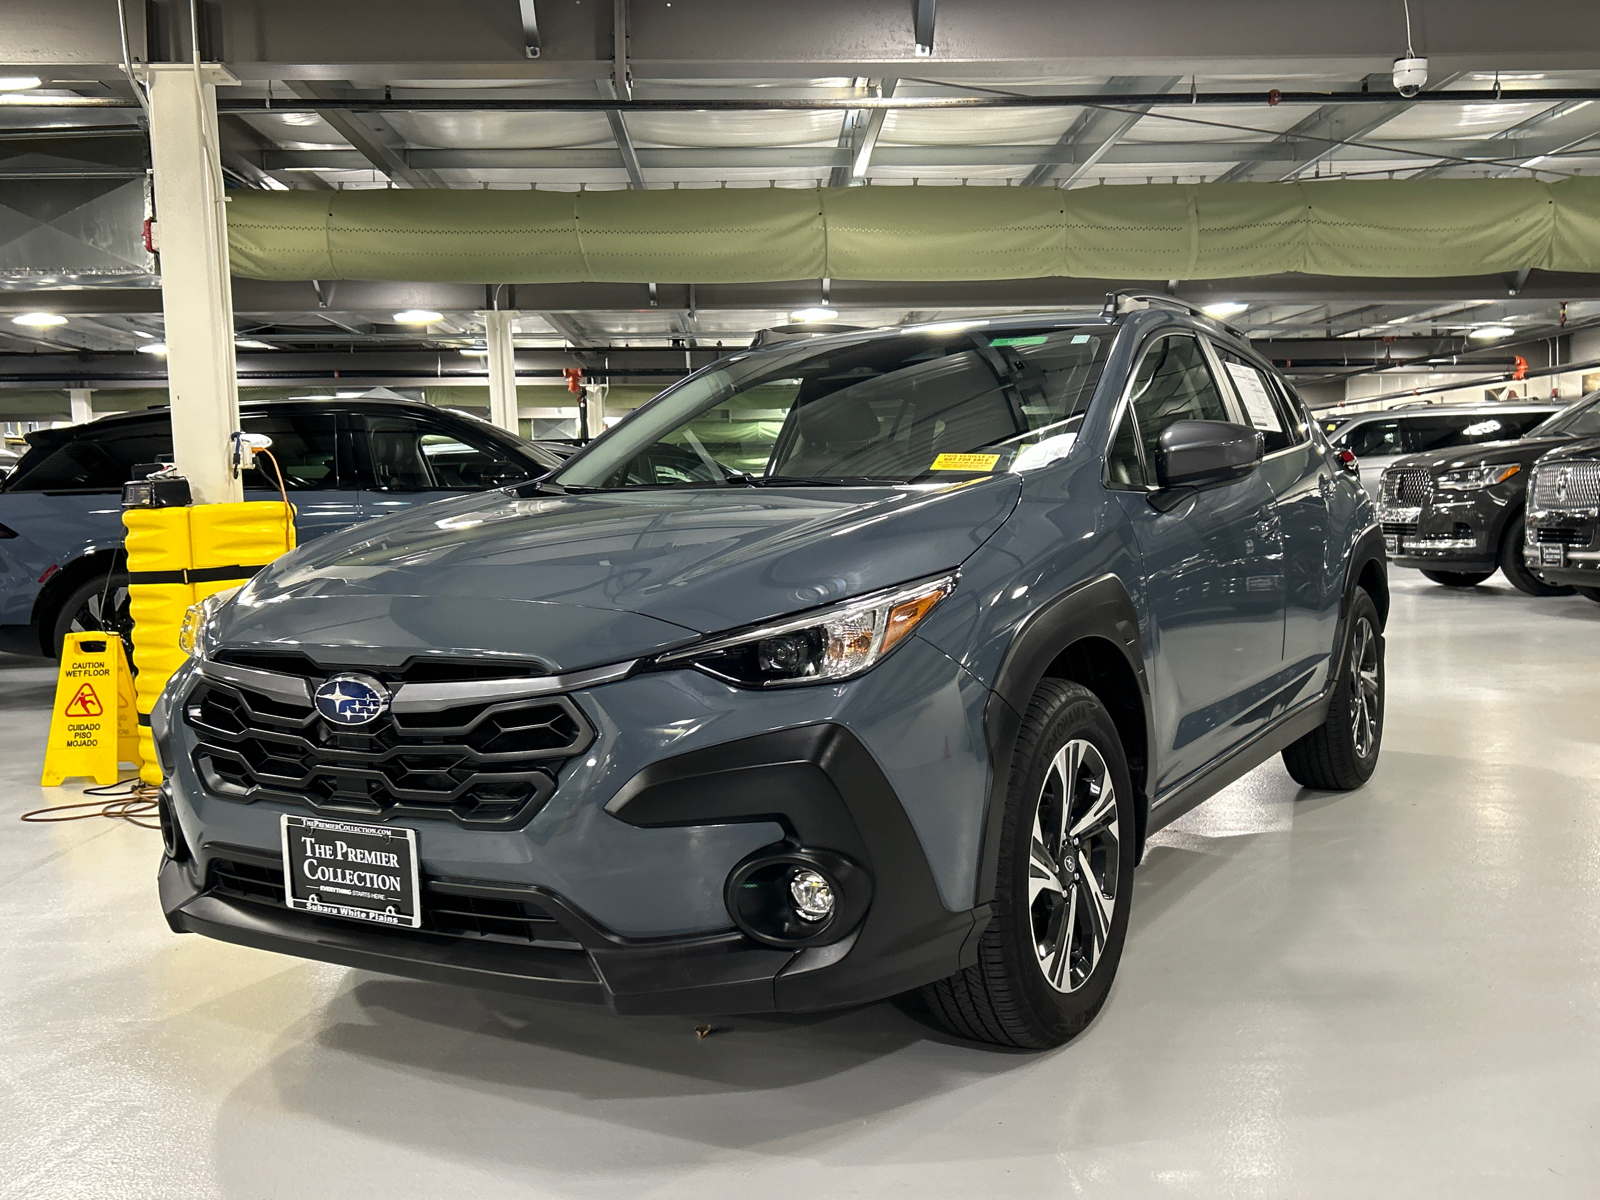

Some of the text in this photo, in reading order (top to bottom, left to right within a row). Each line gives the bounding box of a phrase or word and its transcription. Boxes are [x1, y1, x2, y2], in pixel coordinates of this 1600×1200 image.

[72, 662, 105, 670] CAUTION
[65, 670, 82, 678] WET
[84, 669, 110, 677] FLOOR
[68, 723, 101, 731] CUIDADO
[66, 739, 98, 747] MOJADO
[301, 836, 400, 868] THE PREMIER
[303, 858, 401, 892] COLLECTION
[319, 885, 352, 896] EVERYTHING
[352, 890, 371, 899] STARTS
[306, 902, 399, 924] Subaru White Plains
